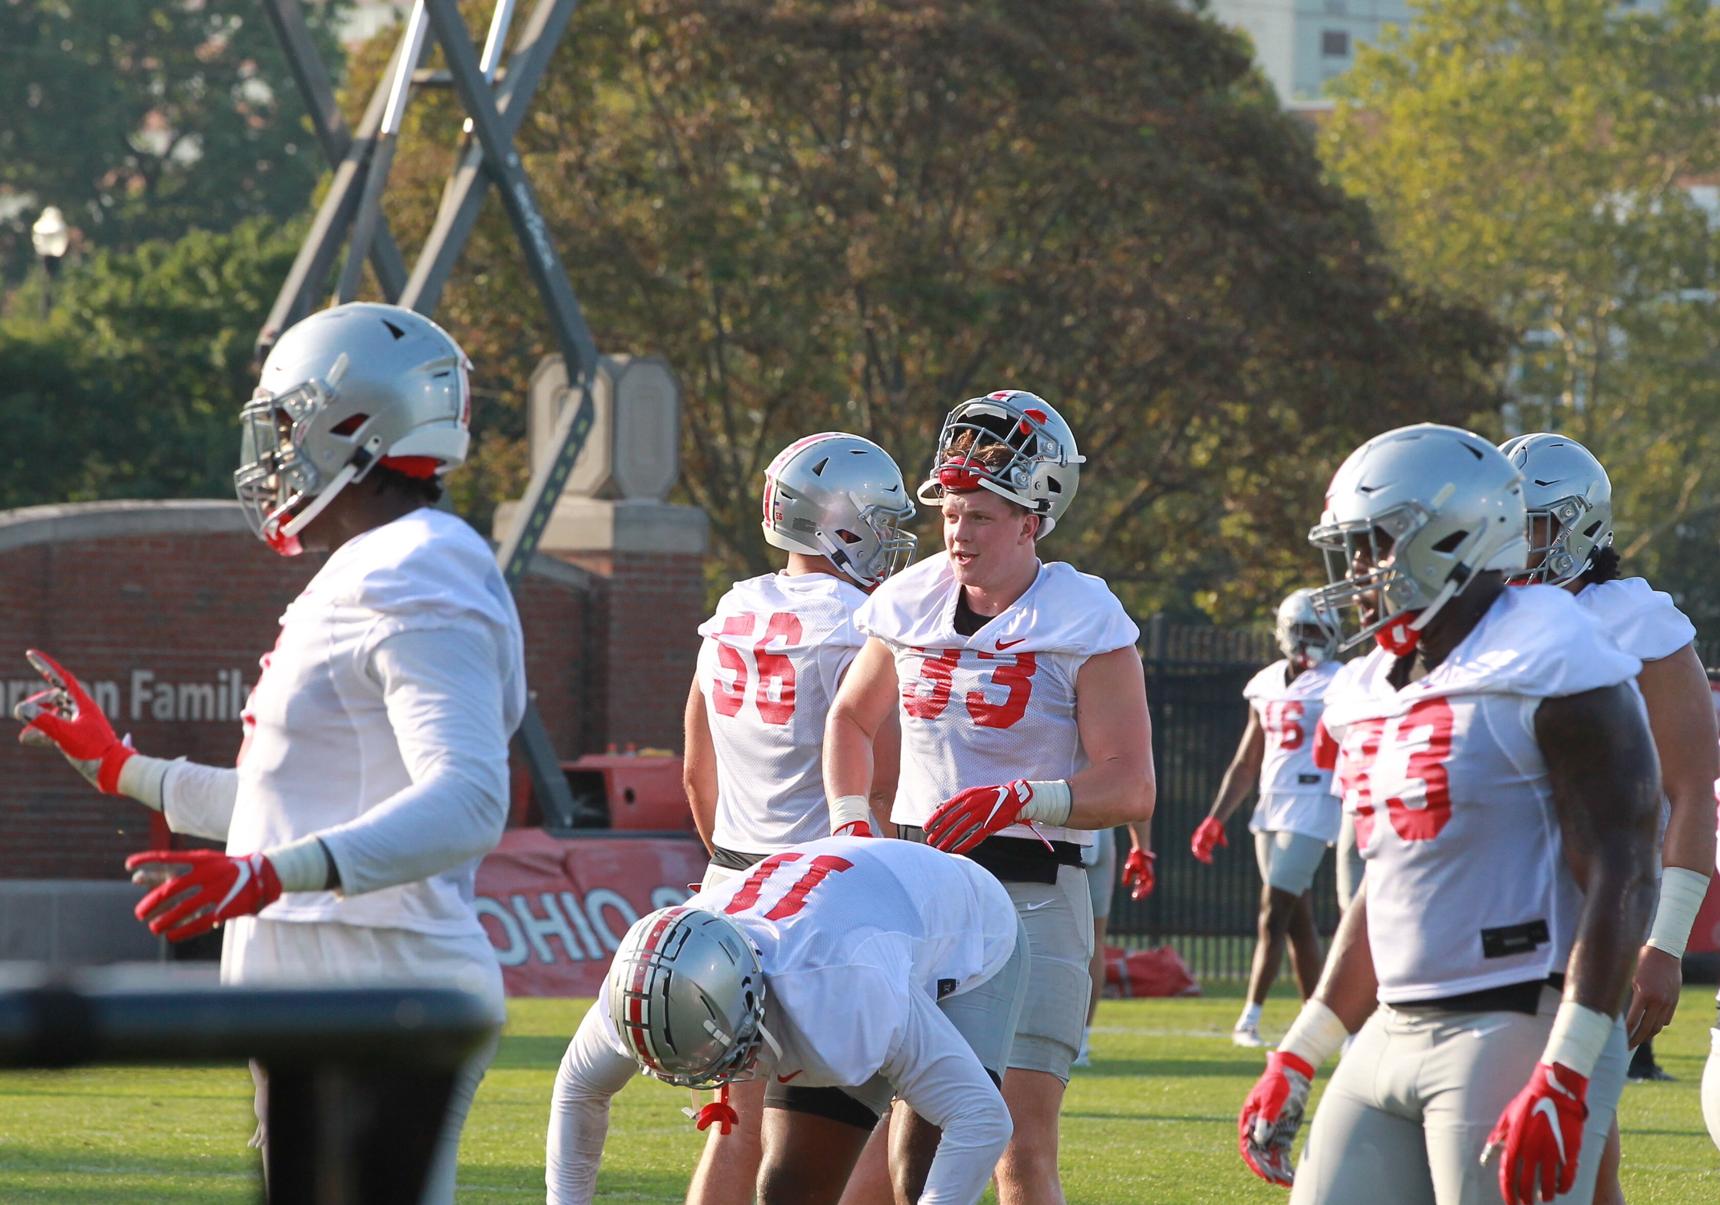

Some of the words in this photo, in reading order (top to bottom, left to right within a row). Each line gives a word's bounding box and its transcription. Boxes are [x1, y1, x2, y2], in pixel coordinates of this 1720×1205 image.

[130, 669, 252, 720] Famil
[712, 612, 802, 725] 56
[724, 852, 855, 921] 11
[475, 887, 640, 966] OHIO
